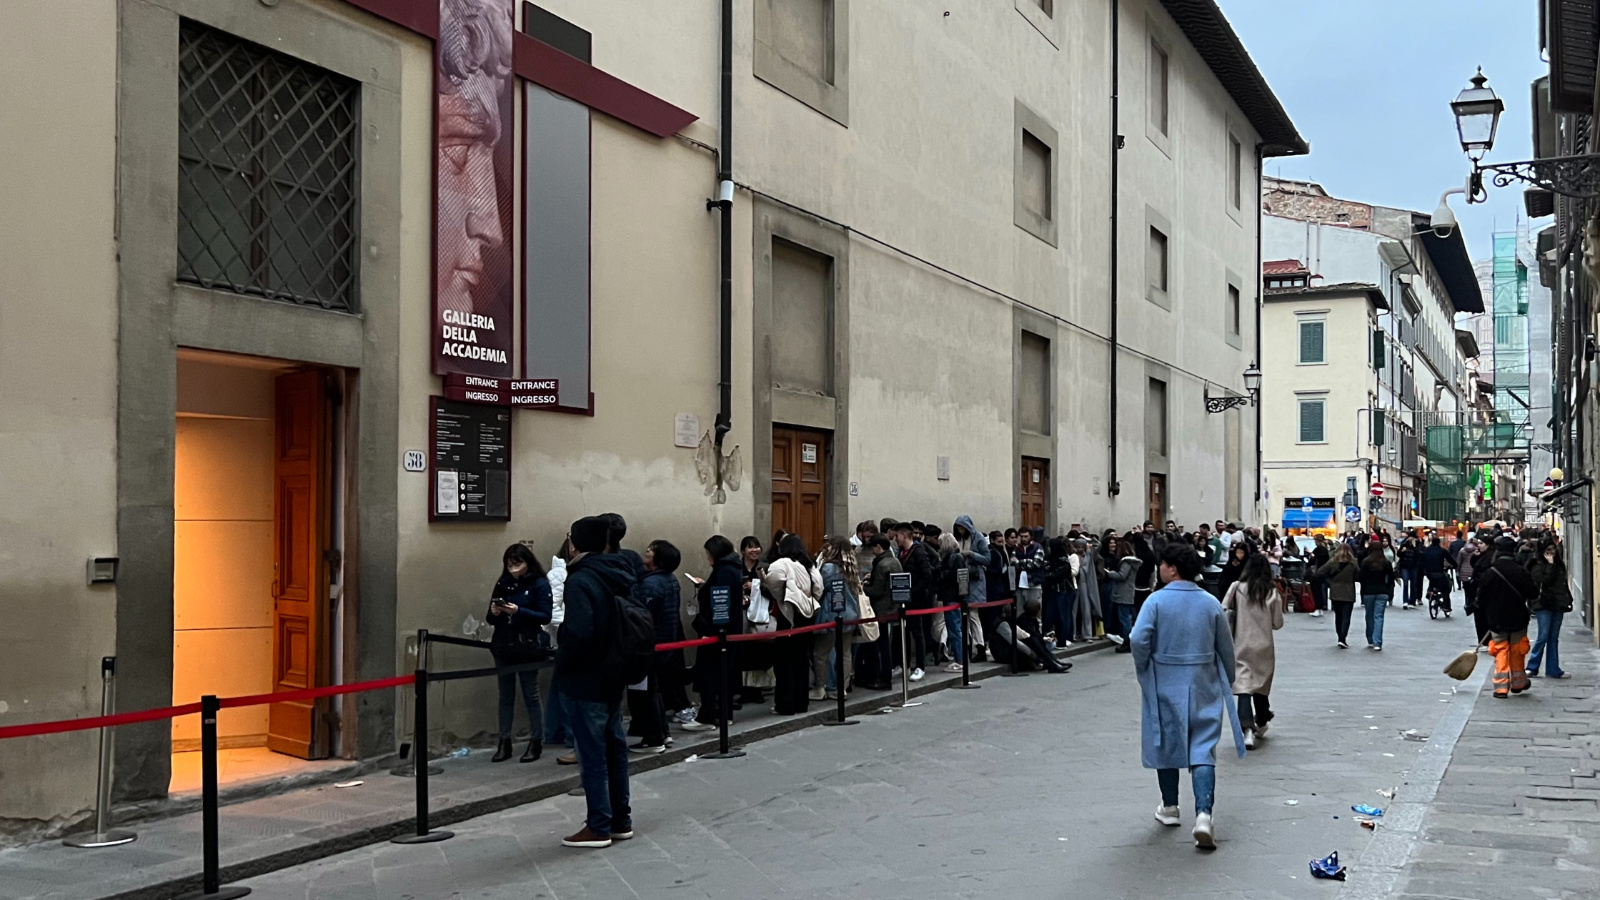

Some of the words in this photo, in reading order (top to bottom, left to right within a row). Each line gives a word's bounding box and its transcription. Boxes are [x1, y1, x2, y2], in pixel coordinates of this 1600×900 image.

[443, 310, 495, 330] GALLERIA
[443, 325, 477, 343] DELLA
[442, 342, 507, 363] ACCADEMIA
[466, 377, 498, 388] ENTRANCE
[511, 381, 555, 390] ENTRANCE
[466, 391, 498, 402] INGRESSO
[511, 395, 556, 404] INGRESSO
[408, 452, 422, 468] 58
[1304, 497, 1312, 506] P
